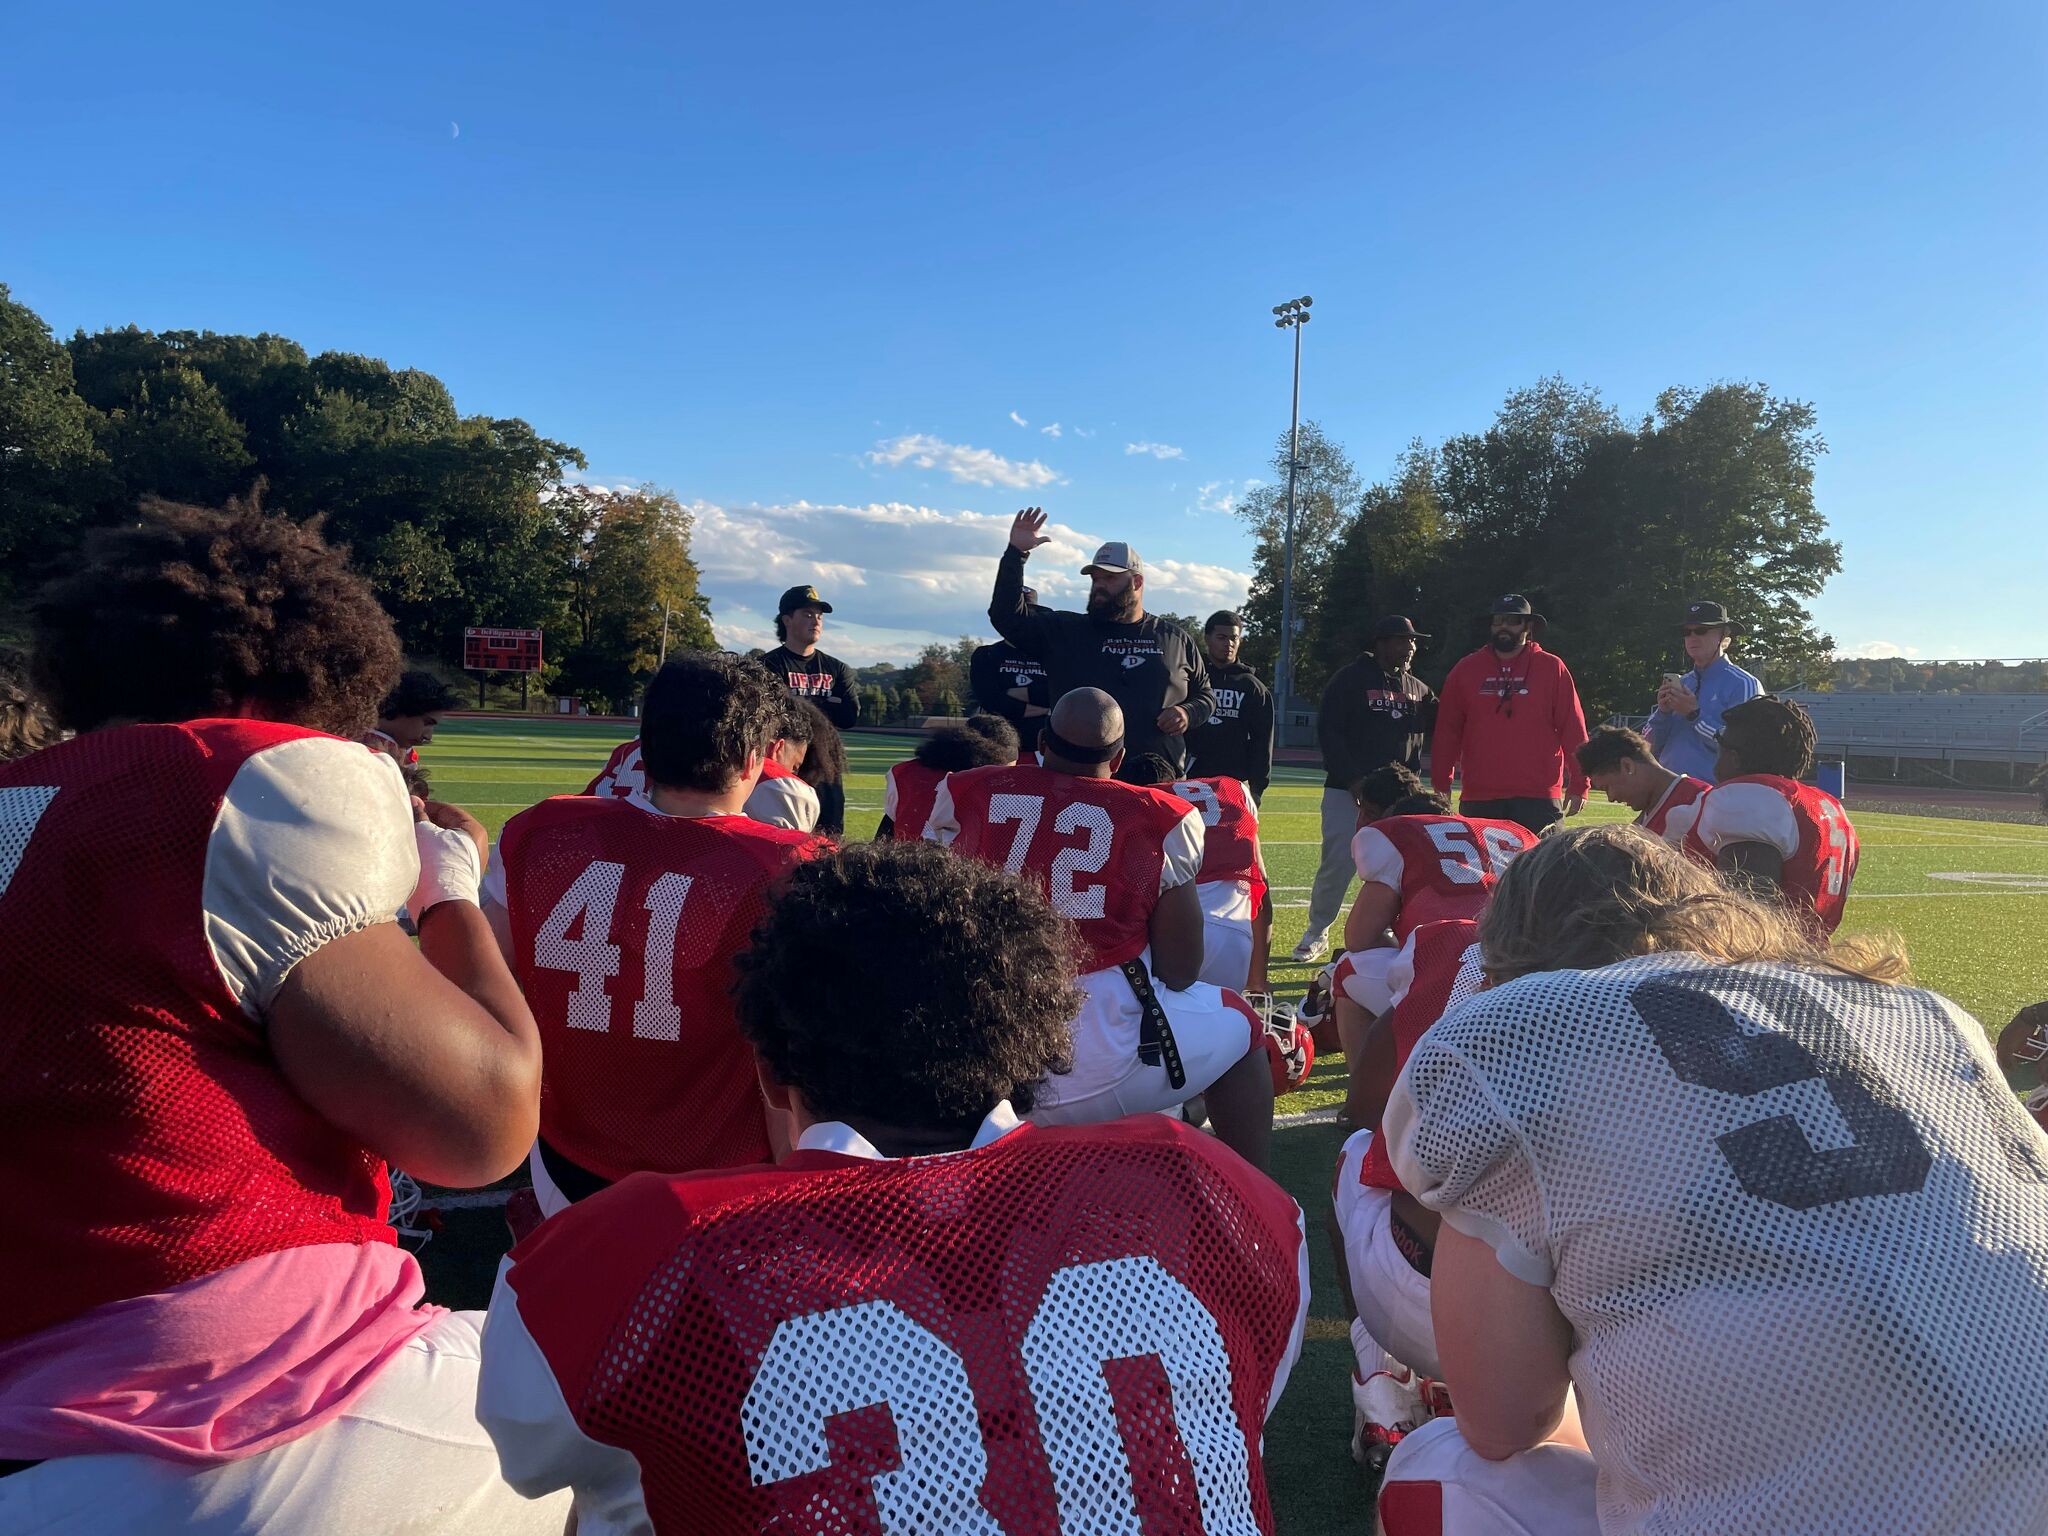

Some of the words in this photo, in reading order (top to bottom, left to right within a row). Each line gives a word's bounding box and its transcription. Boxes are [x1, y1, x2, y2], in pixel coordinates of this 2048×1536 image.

[1213, 688, 1245, 710] RBY
[988, 793, 1115, 920] 72
[534, 860, 694, 1042] 41
